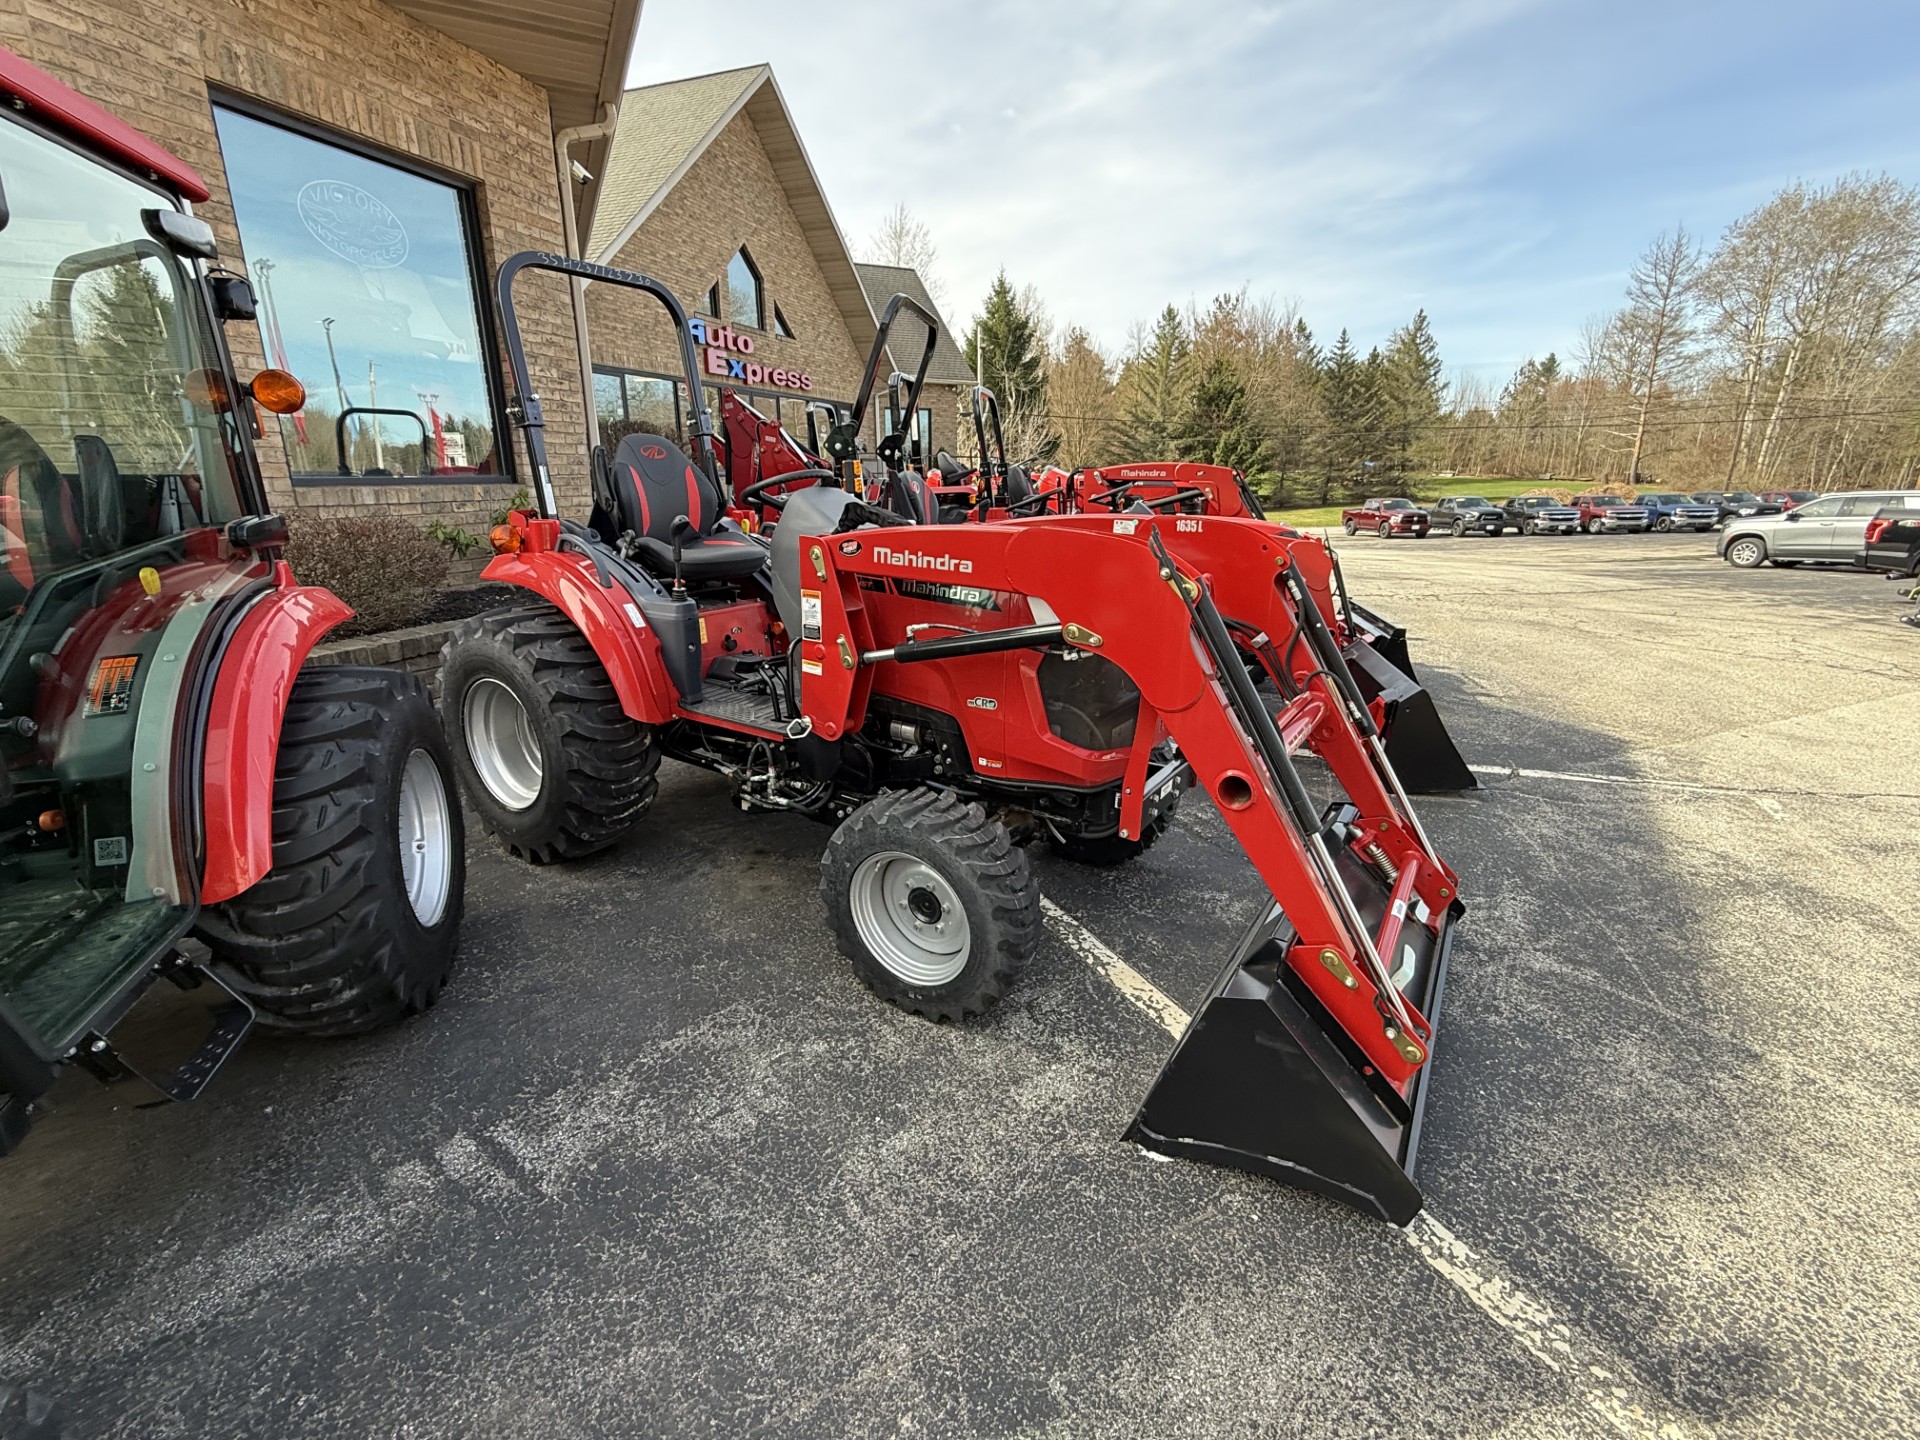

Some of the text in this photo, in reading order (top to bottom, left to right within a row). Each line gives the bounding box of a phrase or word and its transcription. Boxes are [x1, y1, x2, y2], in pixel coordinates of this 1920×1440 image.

[308, 184, 394, 226] VICTORY
[308, 219, 404, 260] MOTORCYCLES
[687, 318, 754, 354] Auto
[704, 347, 813, 391] Express
[1120, 469, 1167, 477] Mahindra
[1176, 520, 1204, 533] 1635 L
[873, 546, 973, 573] Mahindra
[902, 579, 980, 602] Mahindra
